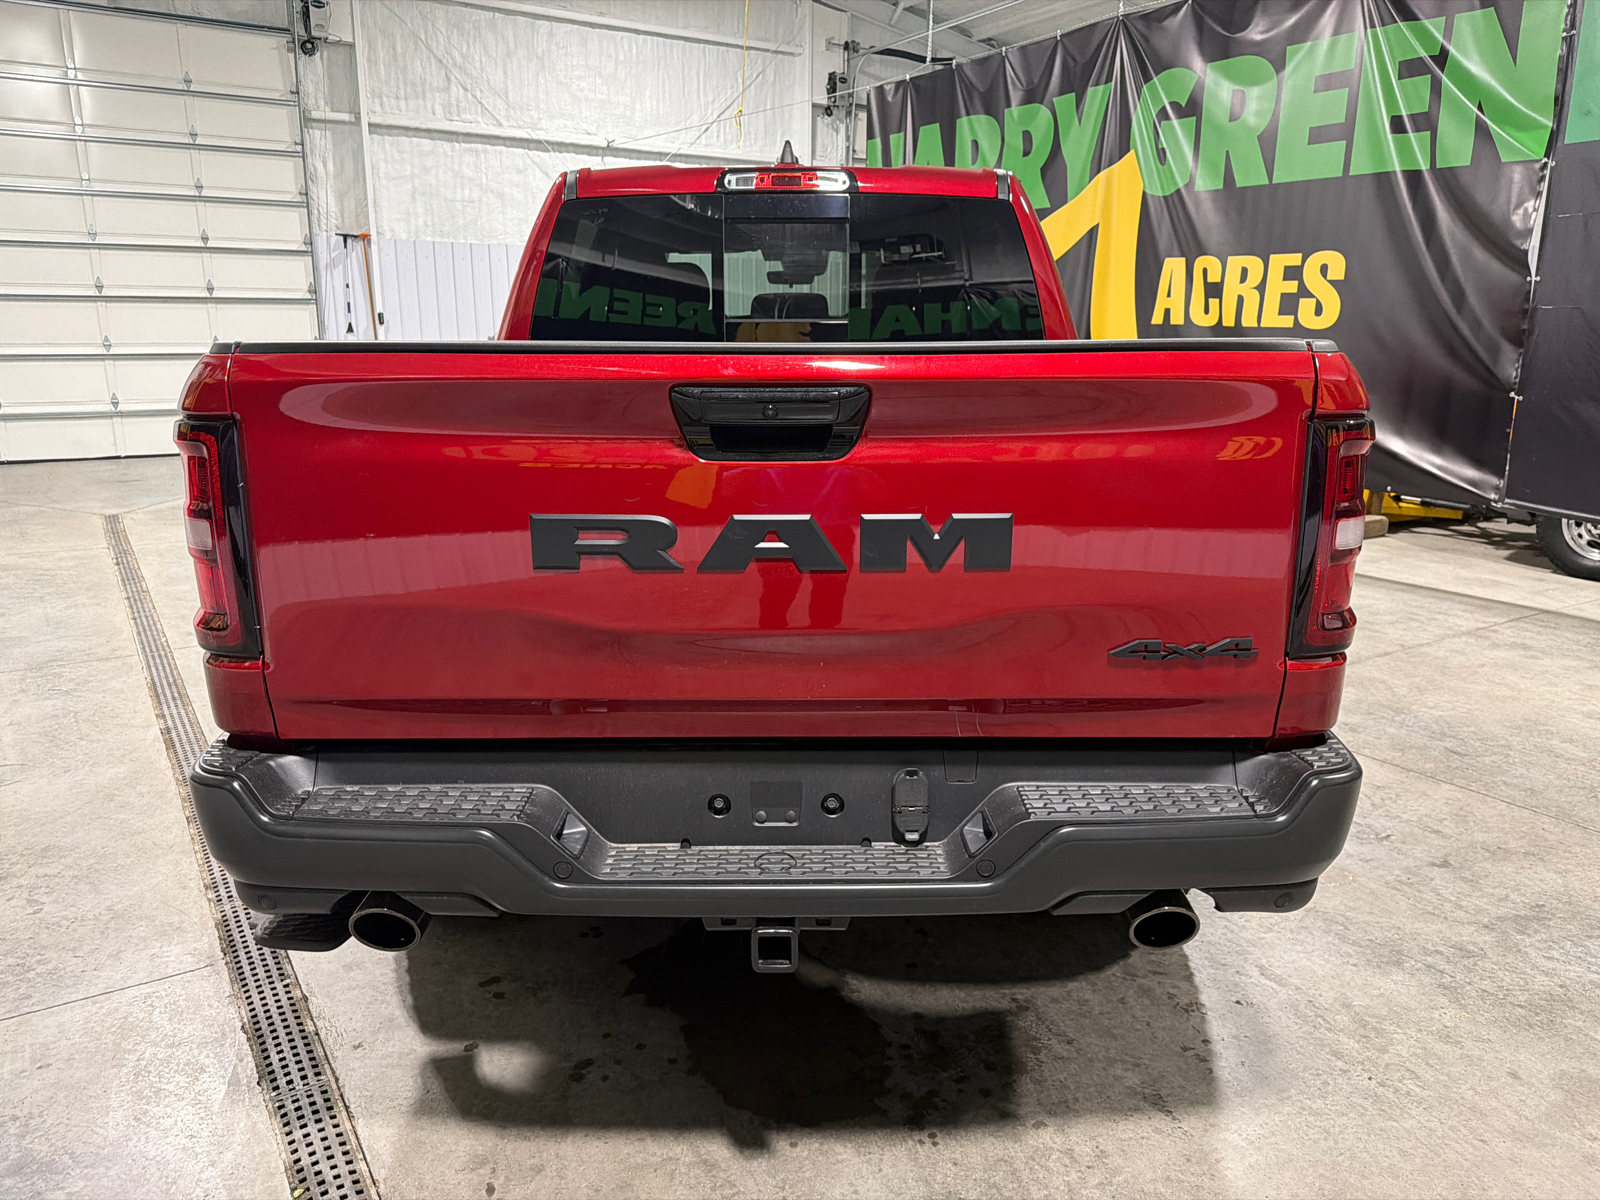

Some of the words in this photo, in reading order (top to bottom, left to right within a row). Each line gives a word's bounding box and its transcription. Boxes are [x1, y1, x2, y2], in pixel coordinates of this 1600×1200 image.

[1131, 0, 1567, 196] GREEN
[1151, 250, 1346, 330] ACRES
[529, 512, 1013, 572] RAM
[1108, 637, 1259, 661] 4x4
